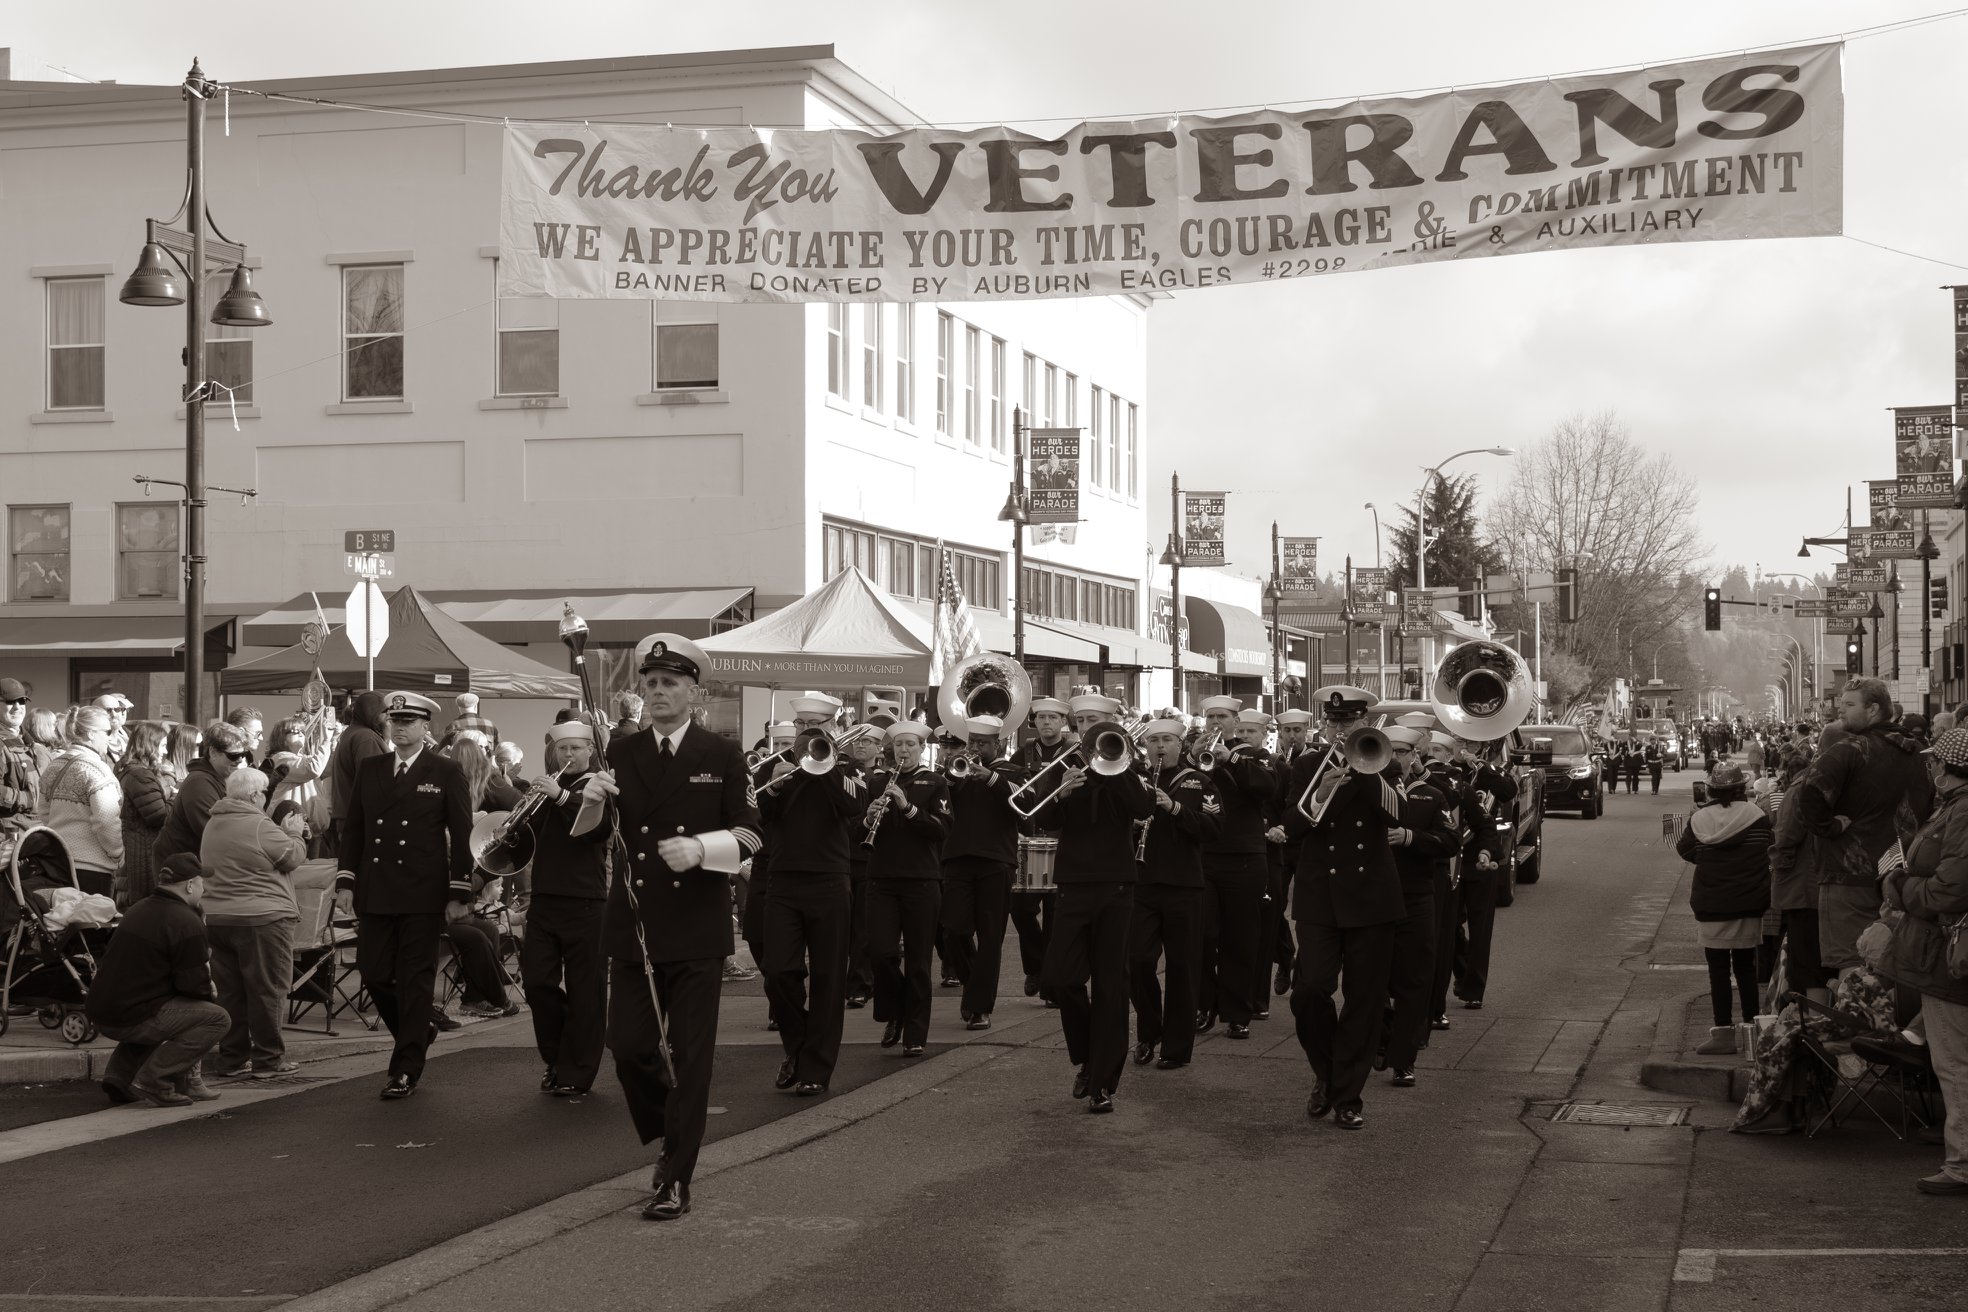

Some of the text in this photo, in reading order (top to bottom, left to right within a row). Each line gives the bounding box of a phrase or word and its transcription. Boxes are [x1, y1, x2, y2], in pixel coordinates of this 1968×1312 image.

[533, 64, 1806, 226] Thank You VETERANS
[533, 151, 1802, 269] WE APPRECIATE YOUR TIME, COURAGE & COMMITMENT
[615, 271, 726, 292] BANNER
[750, 272, 882, 294] DONATED
[913, 276, 948, 294] BY
[974, 272, 1090, 294] AUBURN
[1121, 266, 1231, 289] EAGLES
[1262, 257, 1346, 279] #2298
[1490, 225, 1505, 244] &
[1535, 207, 1704, 240] AUXILIARY
[1915, 416, 1932, 425] our
[1898, 425, 1950, 436] HEROES
[1048, 438, 1063, 446] our
[1032, 446, 1078, 455] HEROES
[1917, 475, 1933, 484] our
[1901, 483, 1951, 494] PARADE
[1033, 499, 1076, 508] PARADE
[1187, 505, 1223, 513] HEROES
[356, 534, 364, 549] B
[381, 533, 391, 542] NE
[1873, 539, 1912, 548] PARADE
[1284, 548, 1316, 556] HEROES
[348, 556, 353, 567] E
[354, 556, 377, 574] MAIN
[1853, 575, 1885, 583] PARADE
[1285, 583, 1314, 591] PARADE
[712, 658, 904, 674] UBURN MORE THAN YOU IMAGINED
